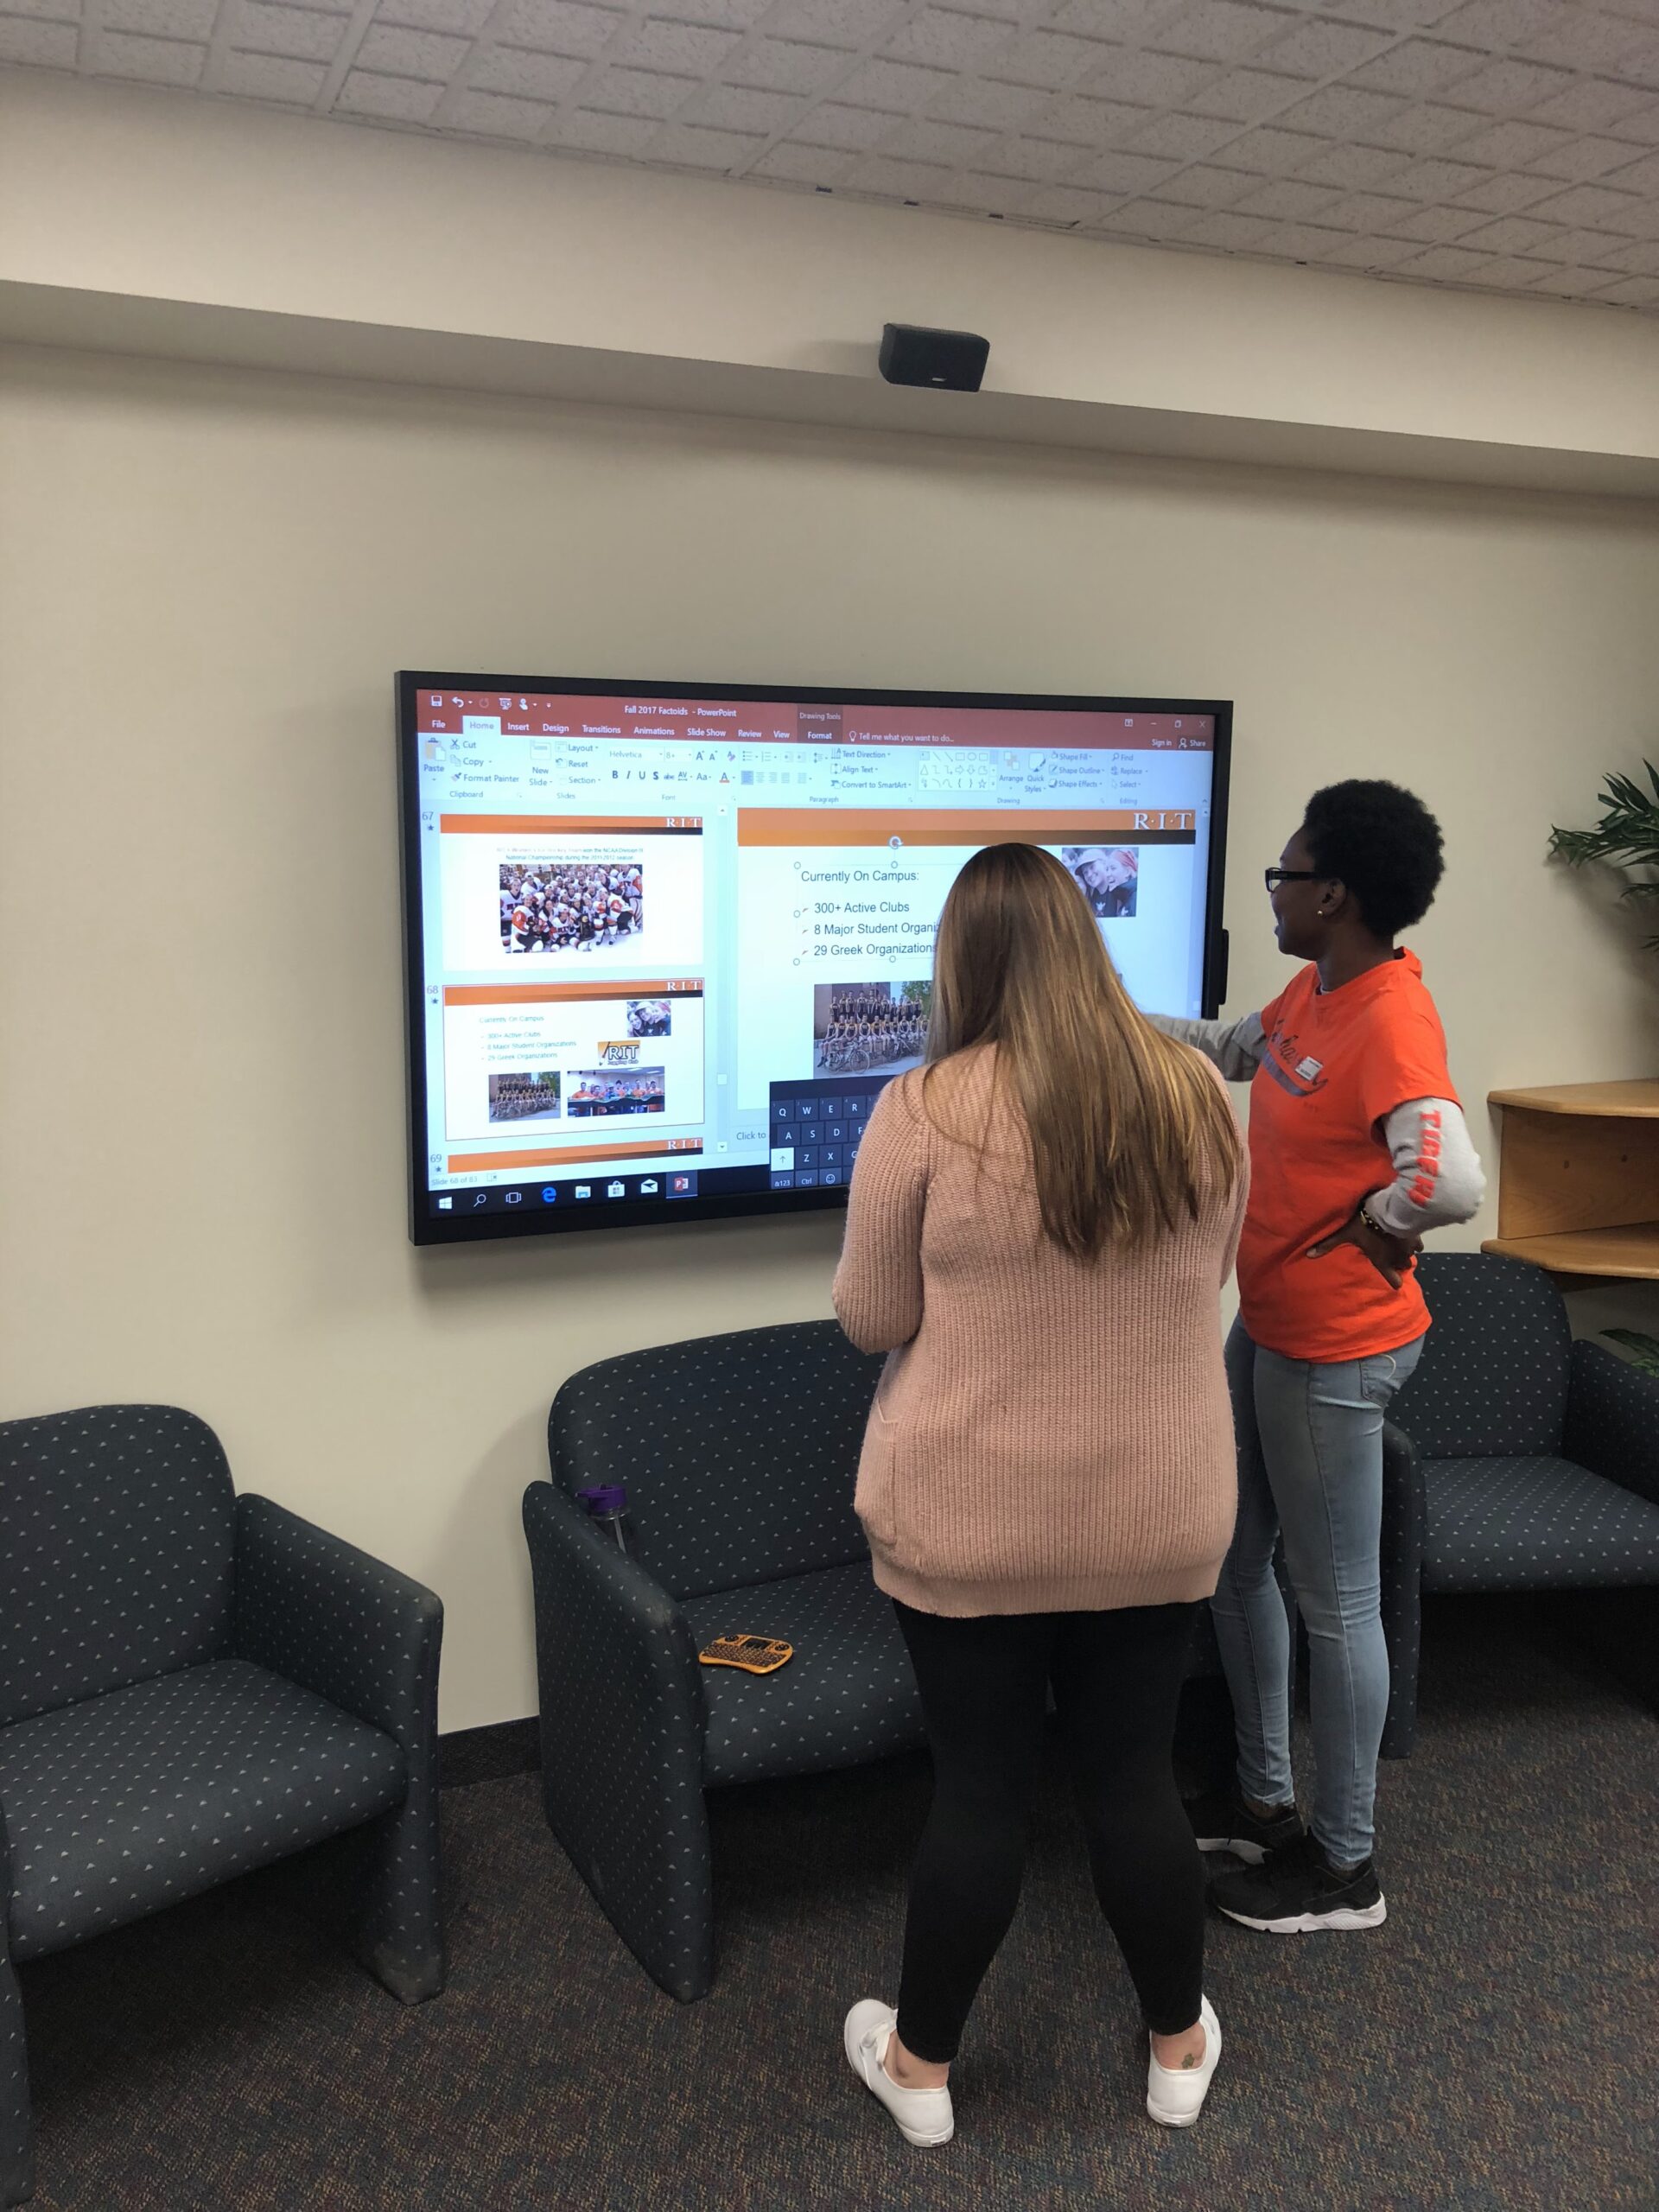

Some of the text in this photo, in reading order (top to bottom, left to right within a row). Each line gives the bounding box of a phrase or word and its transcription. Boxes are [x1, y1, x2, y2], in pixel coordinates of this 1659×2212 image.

[639, 706, 657, 715] 2017
[658, 707, 688, 715] Factoids
[697, 709, 736, 717] PowerPoint
[799, 712, 825, 721] Drawing
[432, 720, 446, 728] File
[469, 721, 494, 730] Home
[543, 724, 569, 733] Design
[582, 725, 621, 734] Transitions
[633, 727, 675, 736] Animations
[687, 728, 726, 737] Slide Show
[773, 730, 790, 739] View
[568, 744, 593, 753] Layout
[609, 750, 642, 759] Helvetica
[463, 758, 484, 767] Copy
[423, 764, 444, 772] Paste
[463, 774, 493, 783] Format
[569, 776, 596, 785] Section
[1027, 774, 1045, 783] Quick
[1025, 785, 1041, 793] Styles
[1058, 780, 1076, 789] Shape
[449, 790, 483, 799] Clipboard
[422, 811, 434, 821] 67
[801, 870, 919, 884] Currently On Campus:
[814, 901, 910, 913] 300+ Active Clubs
[814, 924, 821, 935] 8
[824, 924, 855, 937] Major
[857, 923, 898, 934] Student
[814, 945, 828, 956] 29
[830, 944, 863, 956] Greek
[427, 985, 439, 994] 68
[607, 1044, 639, 1060] RIT
[829, 1105, 834, 1114] E
[852, 1103, 858, 1112] R
[779, 1108, 786, 1117] Q
[736, 1132, 756, 1141] Click
[833, 1128, 841, 1137] D
[430, 1154, 442, 1163] 69
[801, 1177, 812, 1185] Ctrl
